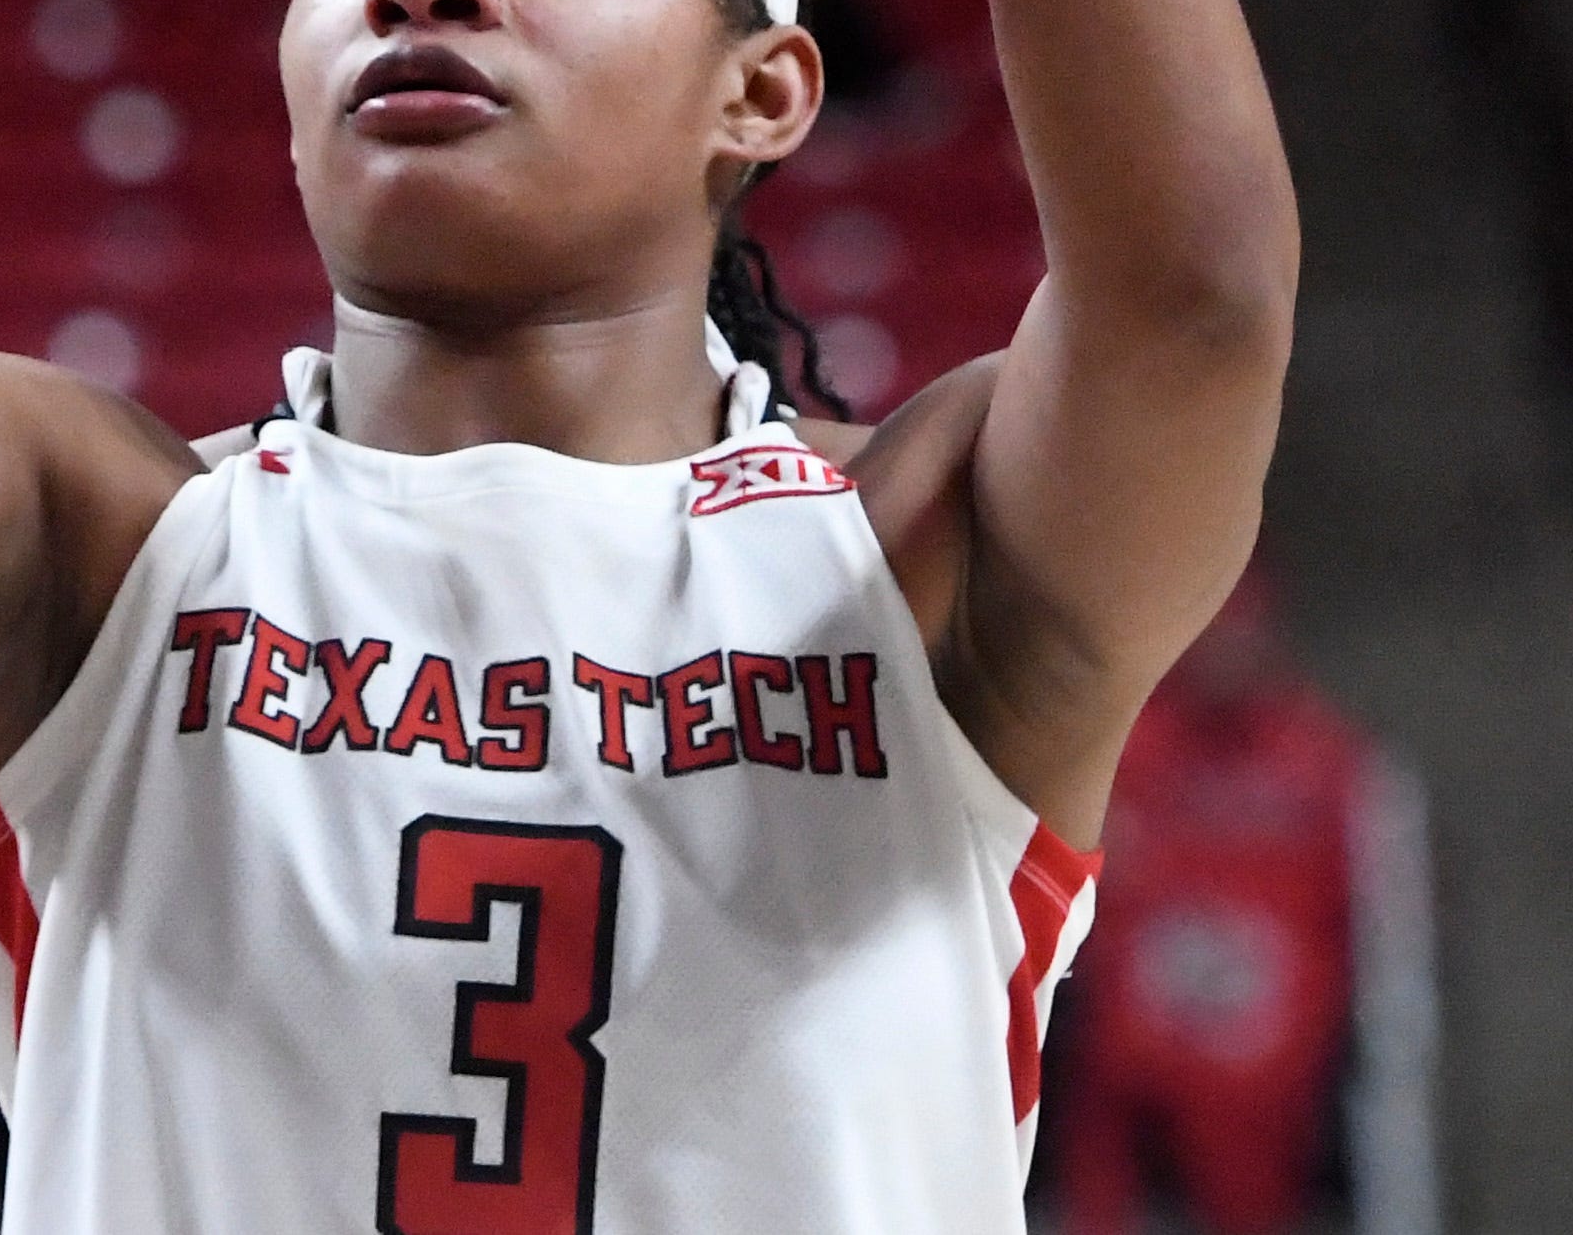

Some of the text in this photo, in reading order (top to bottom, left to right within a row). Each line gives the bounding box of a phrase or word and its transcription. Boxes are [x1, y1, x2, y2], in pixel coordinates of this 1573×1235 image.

[171, 607, 888, 778] TEXAS TECH
[376, 812, 624, 1235] 3
